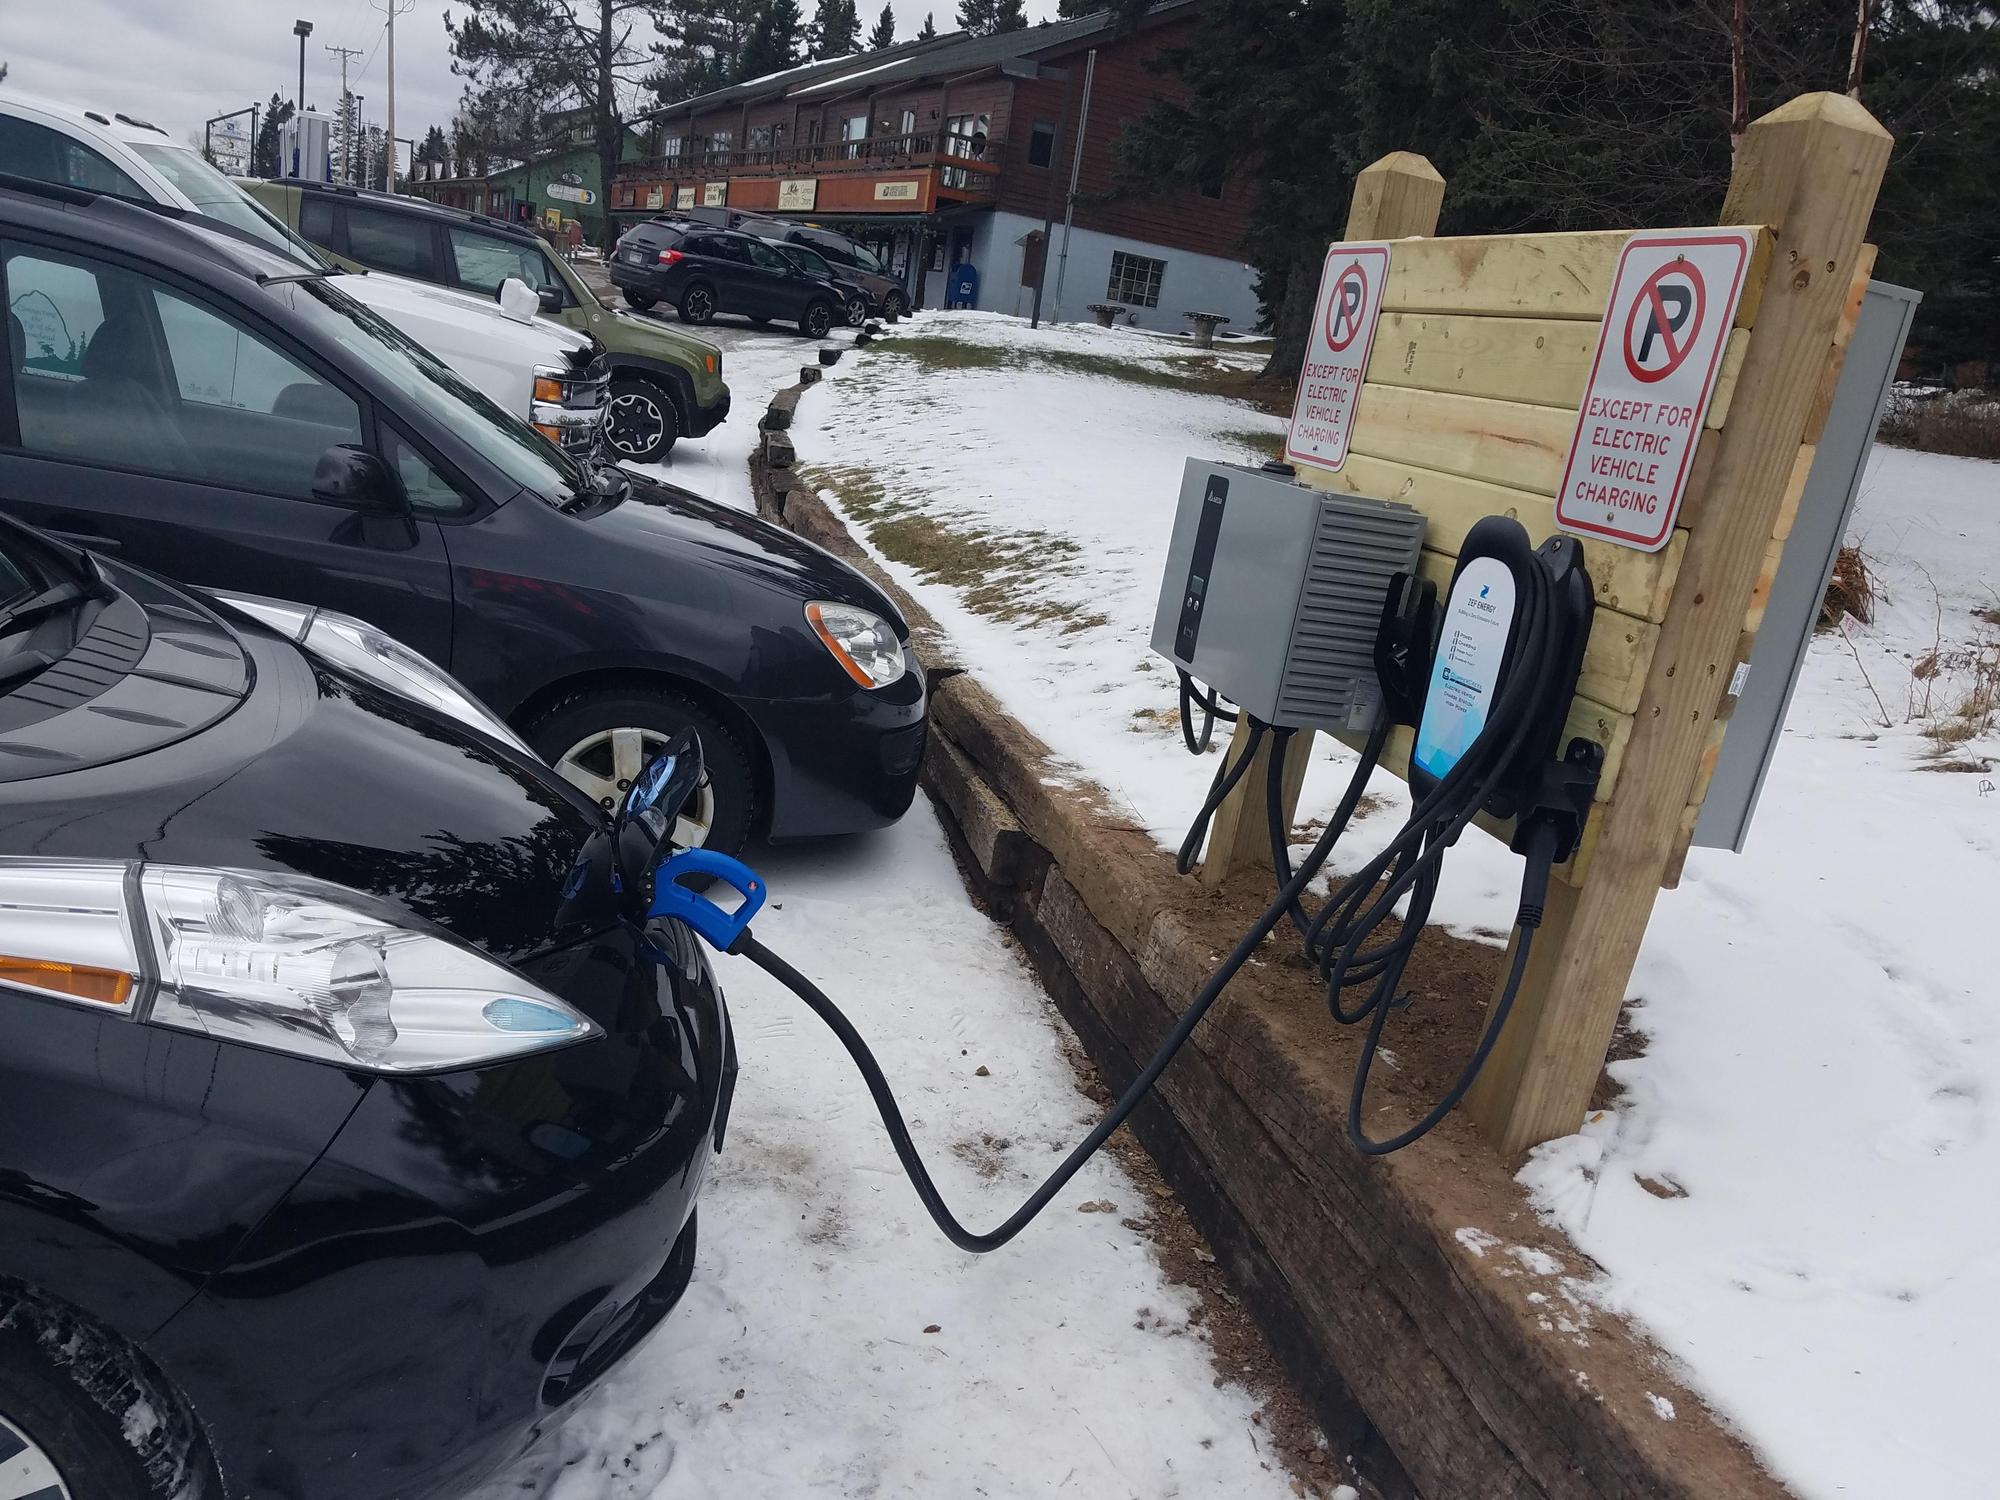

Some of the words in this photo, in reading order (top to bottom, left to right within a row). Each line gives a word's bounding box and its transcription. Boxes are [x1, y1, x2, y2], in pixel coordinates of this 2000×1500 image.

[1306, 363, 1339, 380] EXCEPT
[1340, 367, 1359, 383] FOR
[1307, 384, 1348, 403] ELECTRIC
[1306, 404, 1341, 424] VEHICLE
[1588, 397, 1654, 423] EXCEPT
[1655, 403, 1693, 429] FOR
[1297, 423, 1340, 445] CHARGING
[1591, 426, 1671, 456] ELECTRIC
[1591, 454, 1660, 485] VEHICLE
[1575, 481, 1659, 515] CHARGING
[1467, 597, 1478, 608] ZEF
[1476, 600, 1497, 614] ENERGY
